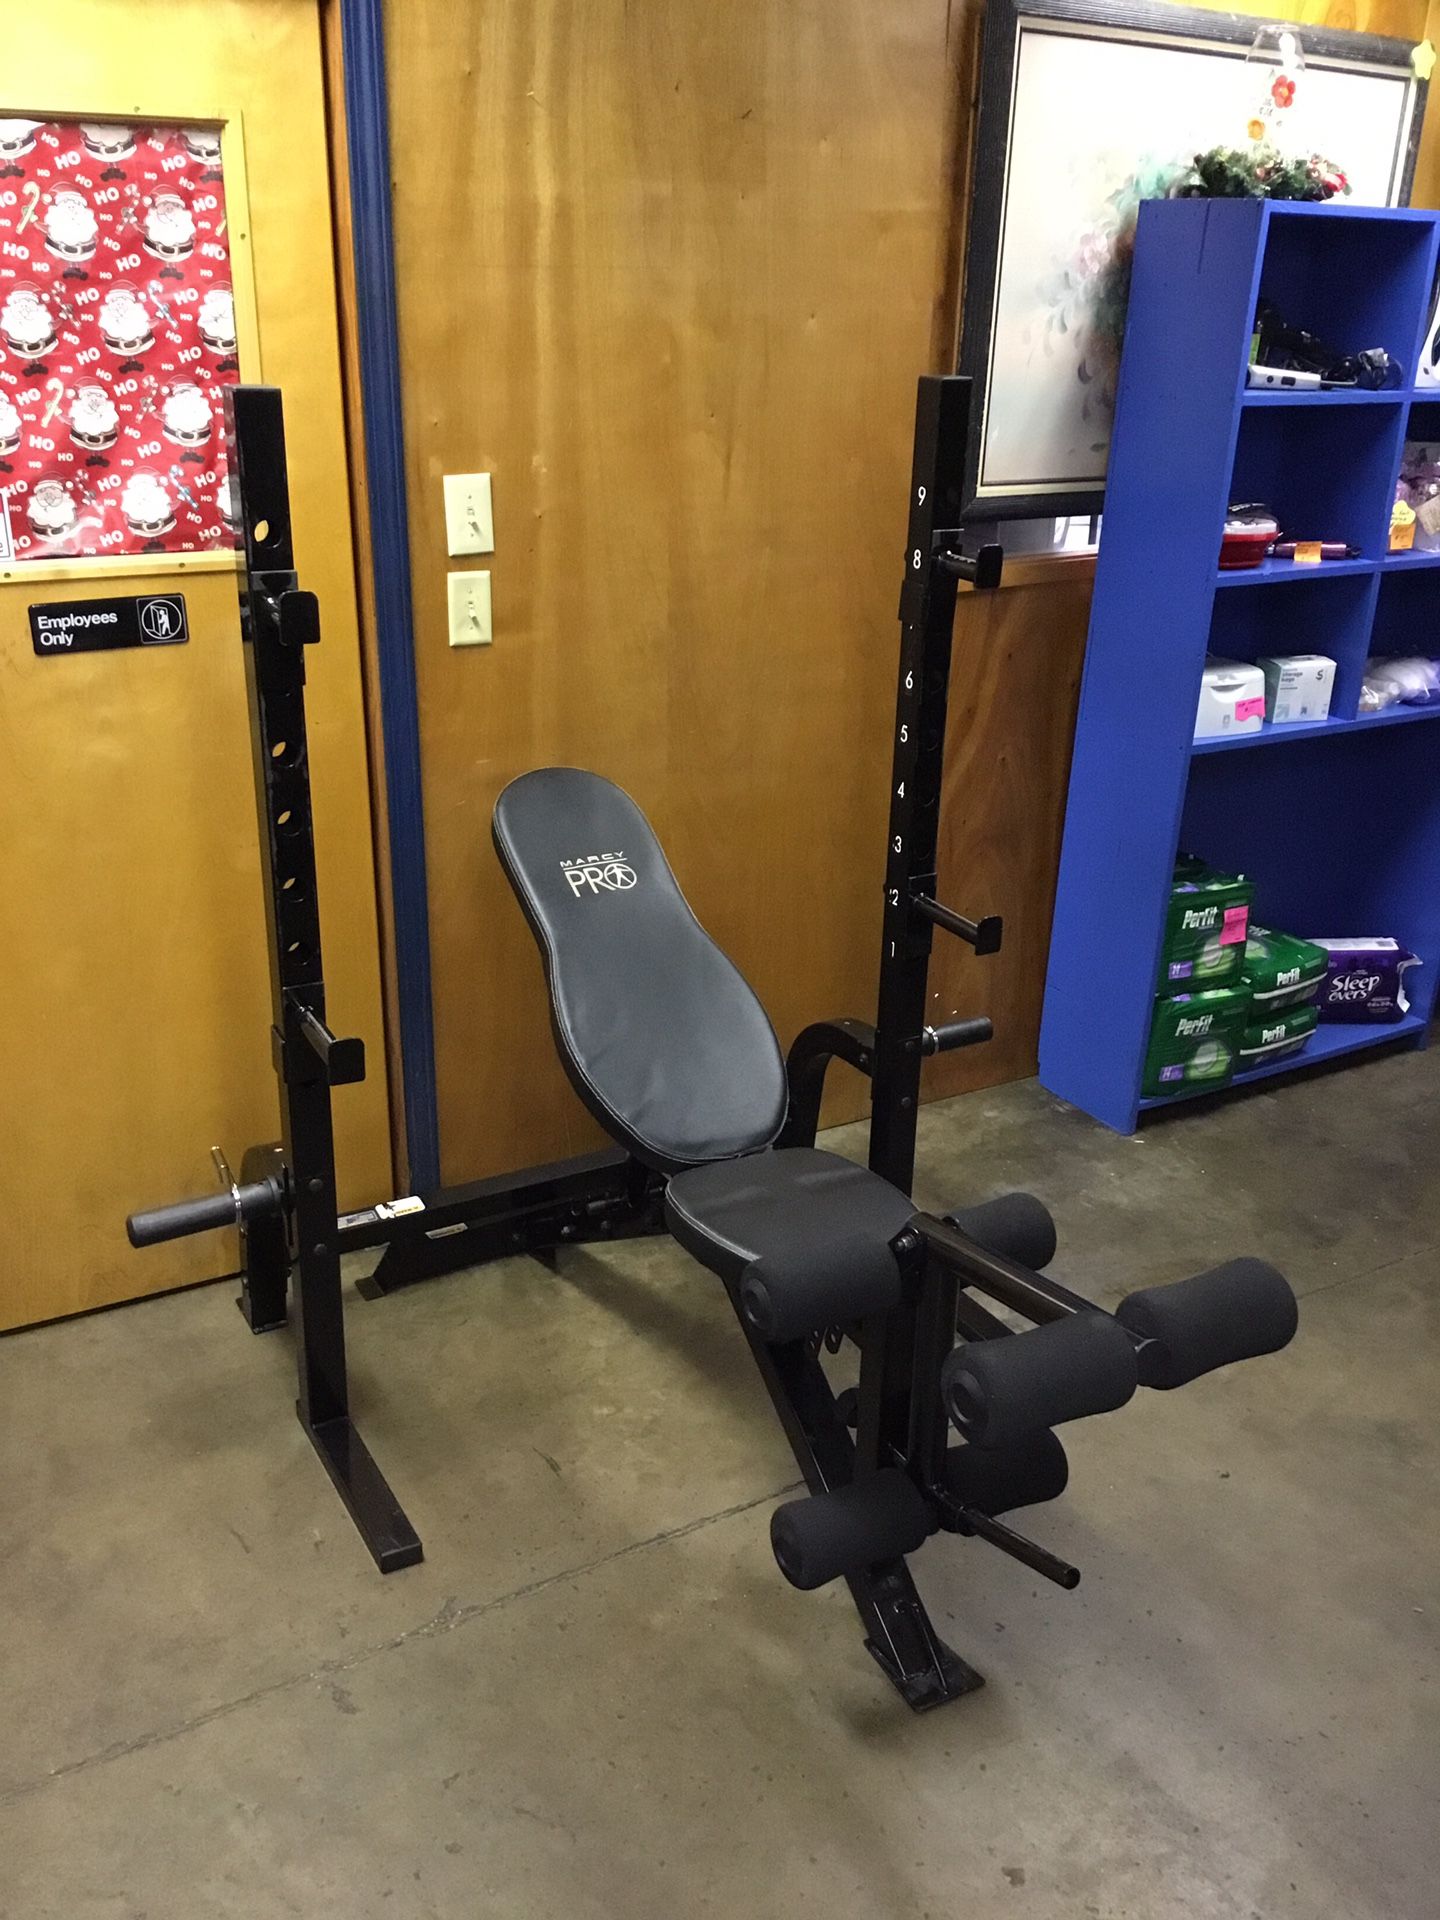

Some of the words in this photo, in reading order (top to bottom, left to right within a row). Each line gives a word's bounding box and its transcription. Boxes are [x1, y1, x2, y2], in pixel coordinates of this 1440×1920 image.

[41, 132, 60, 147] HO
[147, 138, 164, 151] HO
[54, 150, 81, 169] HO
[161, 154, 186, 172] HO
[37, 168, 50, 177] HO
[144, 172, 158, 180] HO
[75, 174, 92, 188] HO
[179, 177, 195, 190] HO
[94, 188, 120, 205] HO
[192, 195, 217, 212] HO
[99, 213, 113, 221] HO
[198, 221, 211, 230] HO
[3, 242, 29, 260] HO
[103, 237, 121, 251] HO
[202, 243, 226, 260] HO
[32, 262, 49, 272] HO
[116, 254, 141, 272] HO
[1, 270, 16, 278] HO
[200, 270, 213, 278] HO
[74, 288, 100, 306] HO
[174, 288, 199, 305] HO
[81, 314, 94, 322] HO
[180, 313, 193, 321] HO
[63, 332, 80, 345] HO
[165, 330, 182, 344] HO
[76, 347, 100, 365] HO
[178, 347, 202, 364] HO
[60, 365, 73, 373] HO
[96, 369, 112, 382] HO
[195, 366, 211, 379] HO
[0, 370, 17, 385] HO
[113, 378, 138, 397] HO
[15, 388, 41, 407] HO
[120, 404, 132, 412] HO
[124, 426, 142, 439] HO
[29, 435, 55, 451] HO
[137, 441, 162, 458] HO
[28, 460, 42, 468] HO
[58, 453, 74, 462] HO
[97, 474, 122, 492] HO
[194, 471, 216, 487] HO
[918, 486, 926, 506] 9
[186, 511, 202, 524] HO
[100, 530, 124, 547] HO
[198, 526, 221, 541] HO
[913, 549, 922, 569] 8
[37, 612, 118, 630] Employees
[40, 631, 73, 646] Only
[906, 671, 913, 689] 6
[1316, 669, 1324, 680] S
[900, 724, 908, 742] 5
[898, 781, 905, 798] 4
[895, 835, 902, 853] 3
[560, 851, 623, 867] MARCY
[891, 941, 895, 958] 1
[1331, 975, 1379, 992] Sleep
